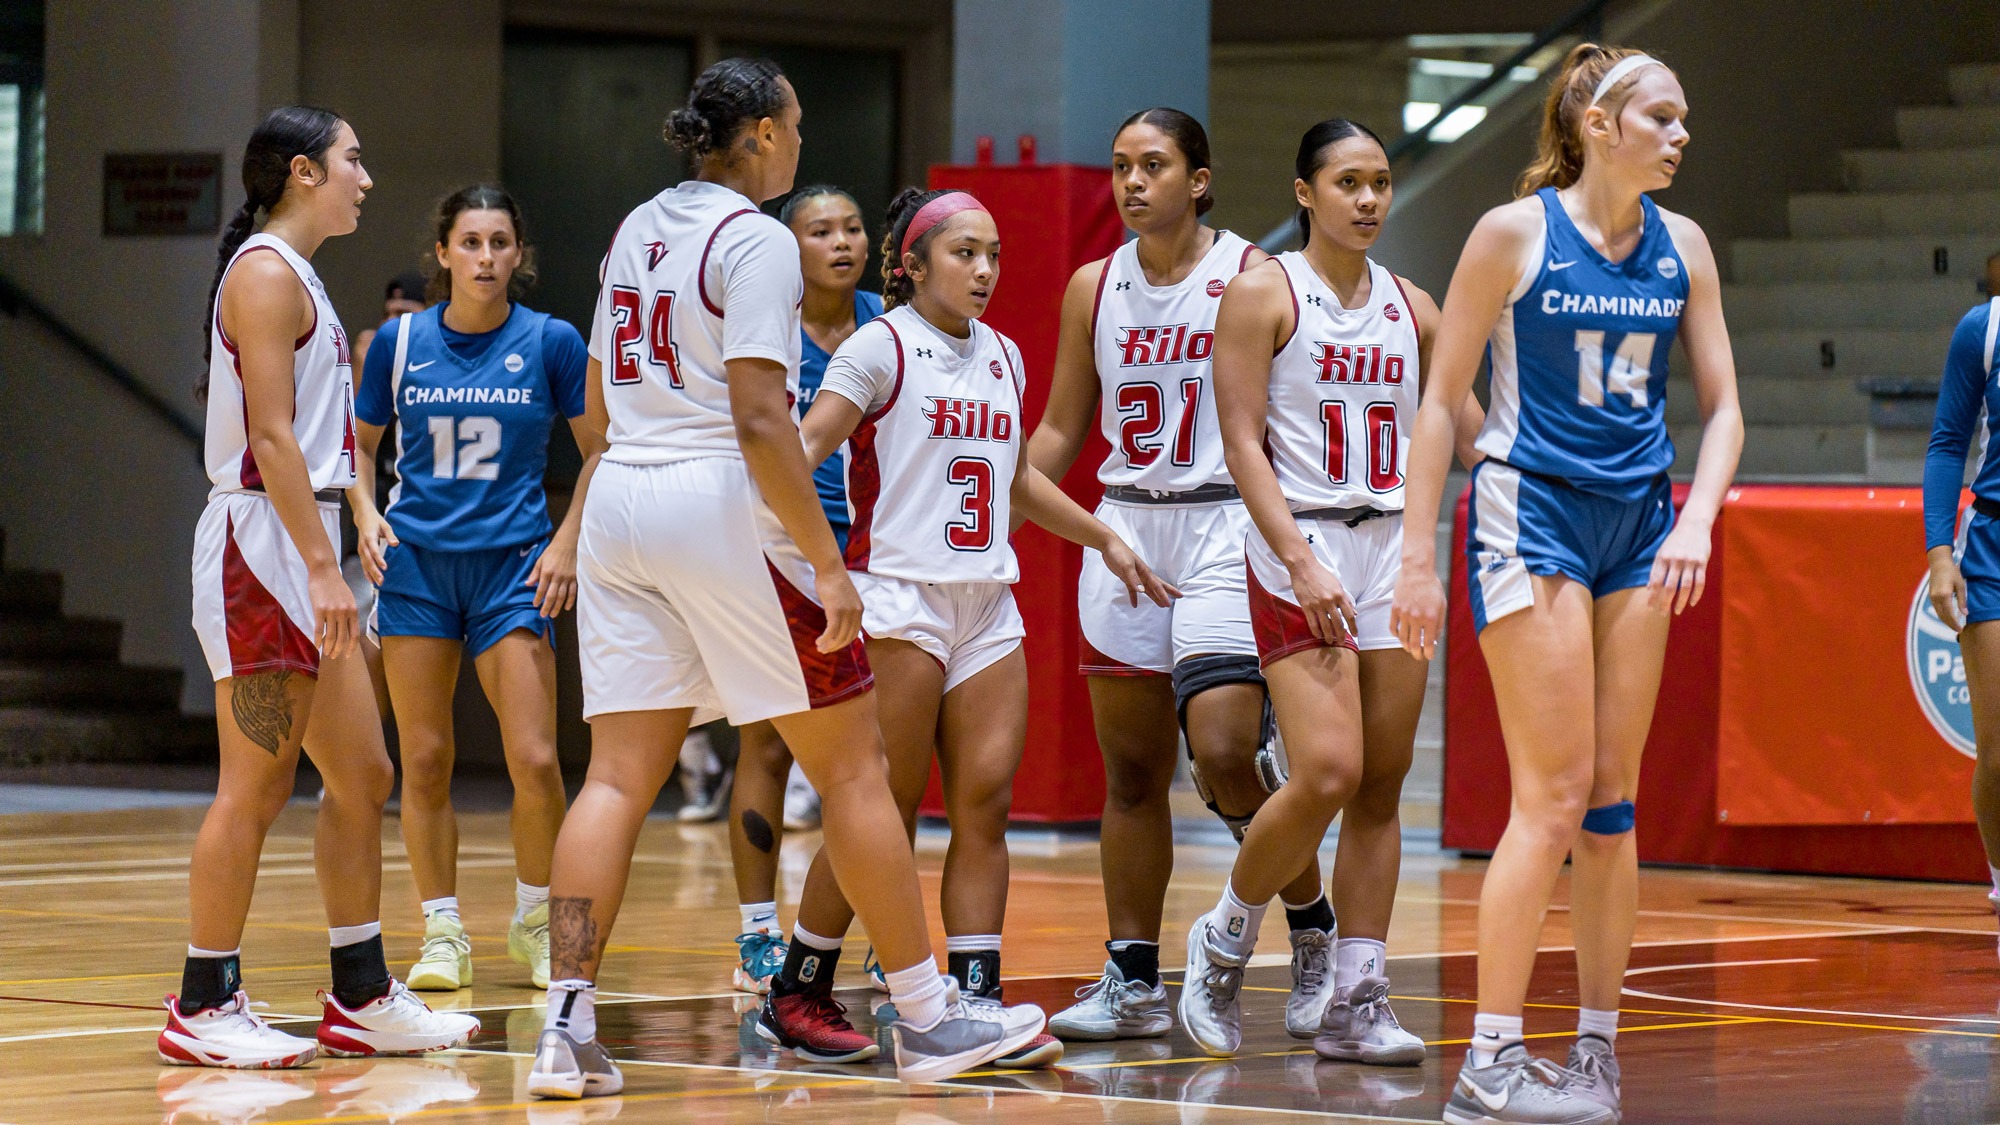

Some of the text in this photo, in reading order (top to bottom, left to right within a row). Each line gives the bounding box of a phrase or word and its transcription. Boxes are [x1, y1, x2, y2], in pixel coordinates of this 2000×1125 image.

[1541, 289, 1685, 317] CHAMINADE
[610, 284, 684, 389] 24
[1115, 322, 1215, 367] Hilo
[1310, 341, 1404, 387] Hilo
[1574, 329, 1657, 408] 14
[405, 385, 533, 406] CHAMINADE
[921, 396, 1012, 443] Hilo
[1116, 376, 1203, 470] 21
[428, 416, 502, 480] 12
[1320, 399, 1405, 494] 10
[945, 456, 995, 552] 3
[1928, 649, 1967, 683] Pa
[1947, 686, 1971, 704] CO
